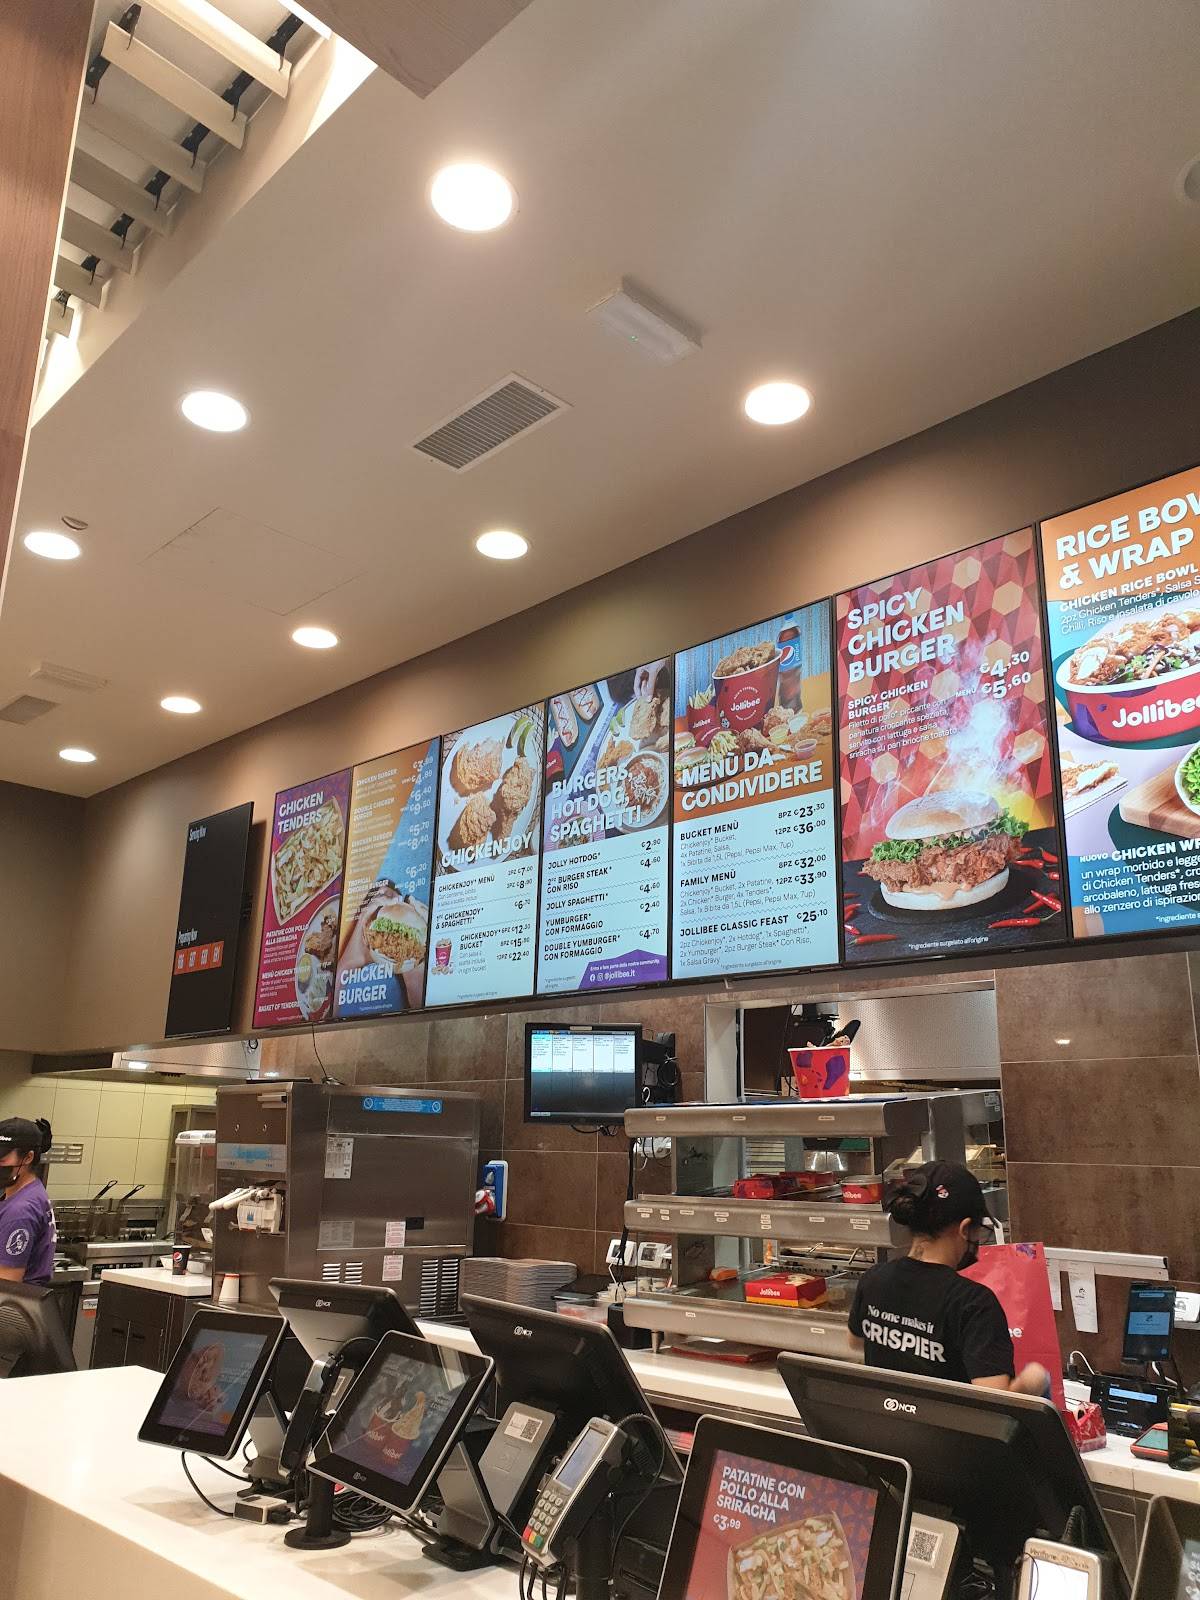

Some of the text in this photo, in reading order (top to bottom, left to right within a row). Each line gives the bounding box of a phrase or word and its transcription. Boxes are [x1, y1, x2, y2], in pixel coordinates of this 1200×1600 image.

[1057, 515, 1130, 560] RICE
[1059, 527, 1194, 590] & WRAP
[1060, 563, 1198, 612] CHICKEN RICE BOWL
[848, 586, 923, 630] SPICY
[1061, 579, 1192, 626] 2pz Chicken Salsa
[1088, 616, 1106, 630] Riso
[1109, 613, 1114, 622] e
[1117, 603, 1154, 619] insalata
[1155, 597, 1166, 608] di
[1168, 589, 1199, 606] cavolo
[848, 601, 964, 656] CHICKEN
[849, 633, 956, 683] BURGER
[731, 698, 760, 711] Jollibee
[848, 680, 928, 710] SPICY CHICKEN
[848, 701, 890, 720] BURGER
[1112, 694, 1200, 728] Jollibe
[682, 747, 774, 788] MENÙ DA
[681, 760, 823, 811] CONDIVIDERE
[279, 792, 324, 818] CHICKEN
[552, 796, 584, 819] HOT
[277, 809, 323, 834] TENDERS
[550, 804, 642, 843] SPAGHETTI
[680, 820, 739, 840] BUCKET MENÙ
[775, 827, 791, 835] 12PZ
[441, 832, 532, 869] CHICKENJOY
[1112, 841, 1176, 861] CHICKEN
[548, 859, 568, 870] JOLLY
[1081, 870, 1093, 879] un
[1095, 867, 1120, 878] wrap
[1123, 859, 1165, 874] morbido
[547, 882, 579, 894] CON RISO
[558, 872, 585, 884] BURGER
[680, 869, 736, 887] FAMILY MENÙ
[776, 876, 792, 885] 12PZ
[1082, 881, 1091, 891] di
[1093, 876, 1133, 890] Chicken
[1083, 883, 1177, 903] arcobaleno, lattuga
[546, 900, 566, 911] JOLLY
[1084, 898, 1152, 915] allo zenzero di
[545, 920, 604, 936] CON FORMAGGIO
[680, 915, 788, 936] JOLLIBEE CLASSIC FEAST
[460, 941, 483, 950] BUCKET
[544, 941, 571, 952] DOUBLE
[544, 946, 603, 961] CON FORMAGGIO
[340, 962, 394, 986] CHICKEN
[339, 984, 387, 1006] BURGER
[868, 1304, 935, 1334] No one makes it
[861, 1319, 947, 1362] CRISPIER
[898, 1403, 917, 1414] NCR
[722, 1466, 806, 1500] PATATINE CON
[720, 1480, 790, 1511] POLLO ALLA
[716, 1494, 777, 1523] SRIRACHA
